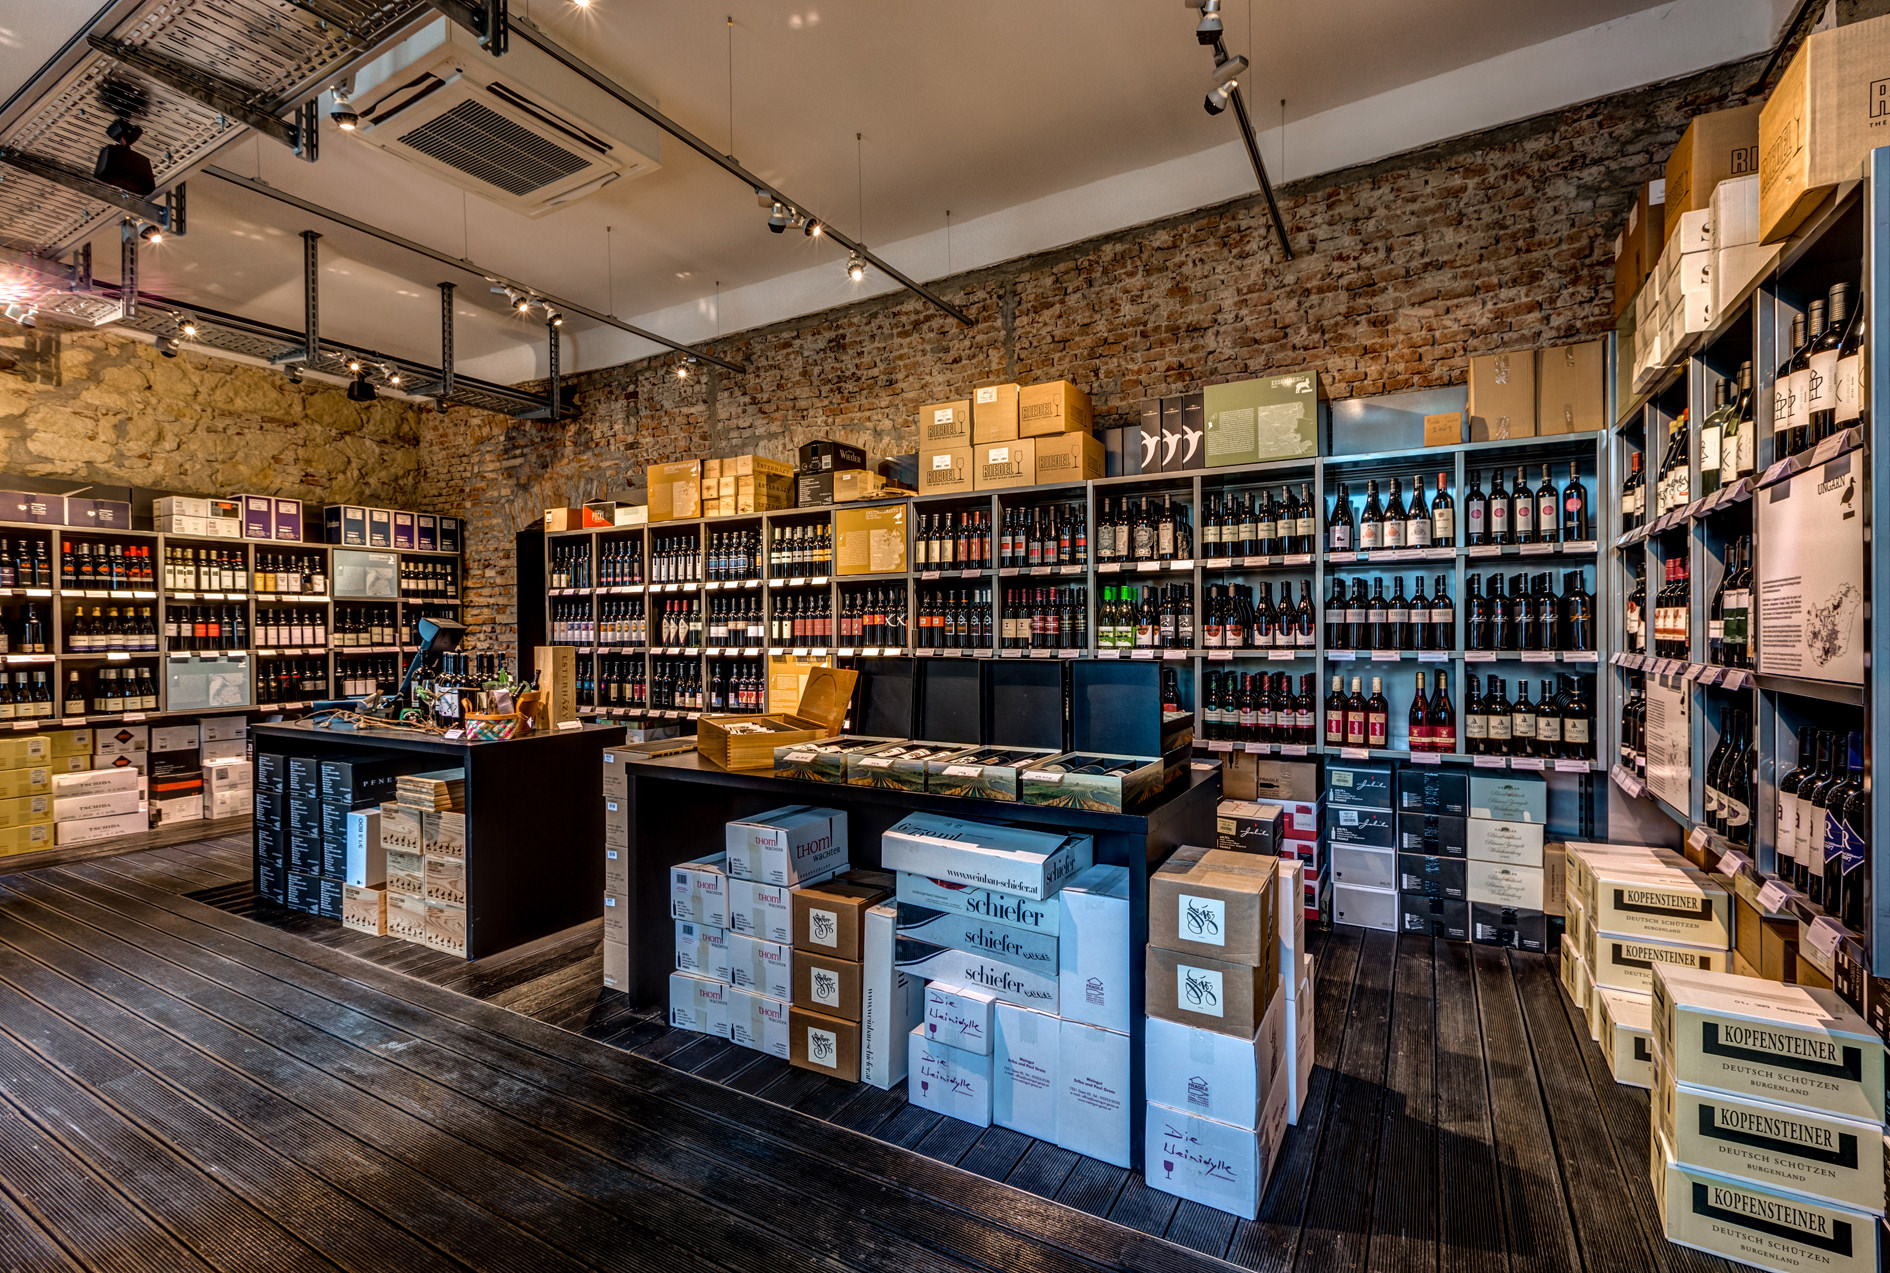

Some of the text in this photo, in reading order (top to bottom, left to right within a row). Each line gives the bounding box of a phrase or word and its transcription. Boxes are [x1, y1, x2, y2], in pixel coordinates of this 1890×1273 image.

[1022, 403, 1052, 420] RIEDEL
[928, 422, 957, 438] RIEDEL
[983, 462, 1014, 478] RIEDEL
[1039, 453, 1070, 468] RIEDEL
[927, 468, 956, 483] RIEDEL
[1817, 475, 1845, 495] UNGARN
[363, 776, 398, 788] PFNE
[80, 803, 111, 811] TSCHIDA
[947, 869, 1039, 895] www.weinbau-schiefer.at
[1046, 858, 1076, 885] schiefer
[966, 892, 1044, 927] schiefer
[1627, 889, 1698, 911] KOPFENSTEINER
[1626, 915, 1699, 929] DEUTSCH SCHÜTZEN
[1644, 925, 1681, 934] BURGENLAND
[964, 928, 1023, 955] schiefer
[1626, 944, 1696, 966] KOPFENSTEINER
[965, 965, 1024, 993] schiefer
[1624, 970, 1652, 979] DEUTSC
[930, 992, 958, 1009] Die
[1724, 1025, 1837, 1063] KOPFENSTEINER
[921, 1050, 949, 1068] Die
[1722, 1063, 1840, 1092] DEUTSCH SCHÜTZEN
[1750, 1079, 1809, 1097] BURGENLAND
[1165, 1124, 1202, 1146] Die
[1721, 1108, 1833, 1148] KOPFENSTEINER
[1718, 1145, 1837, 1178] DEUTSCH SCHÜTZEN
[1747, 1163, 1806, 1182] BURGENLAND
[1714, 1187, 1827, 1234] KOPFENSTEINER
[1712, 1224, 1831, 1265] DEUTSCH SCHÜTZEN
[1740, 1244, 1800, 1267] BURGENLAND
